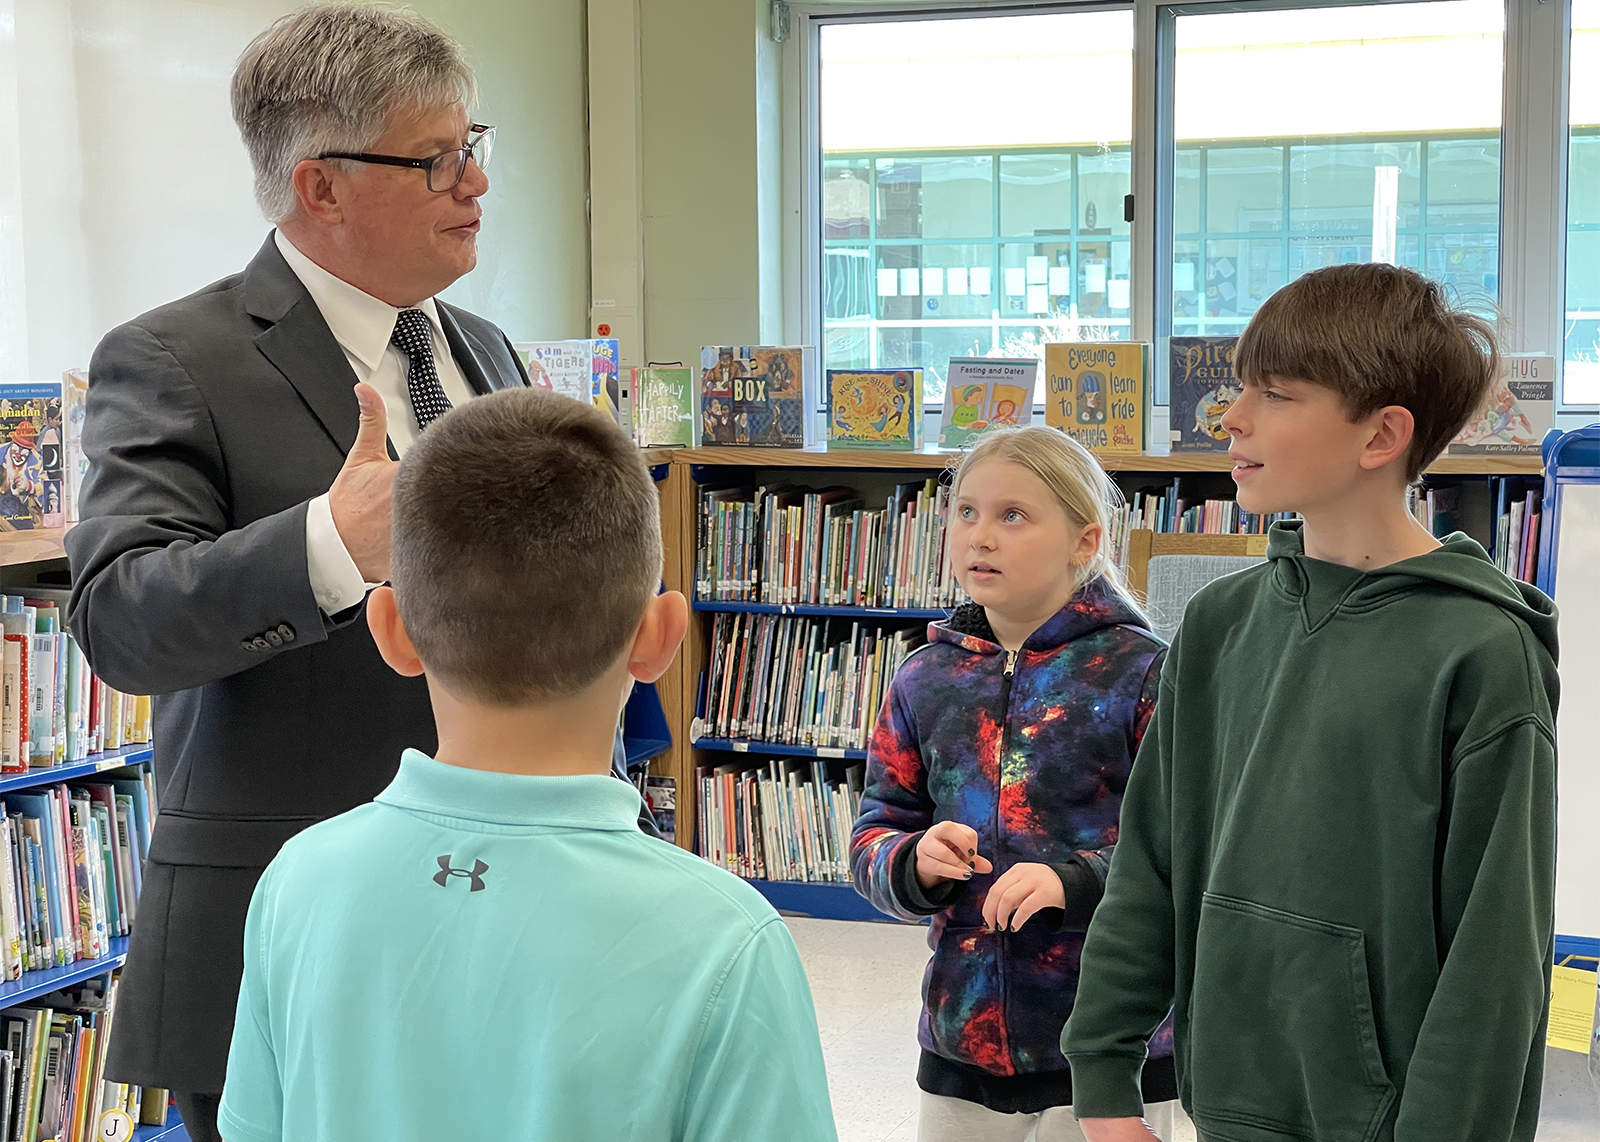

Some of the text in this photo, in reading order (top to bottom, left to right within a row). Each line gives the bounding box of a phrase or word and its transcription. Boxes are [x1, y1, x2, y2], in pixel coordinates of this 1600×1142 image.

[535, 347, 562, 360] Sam
[592, 344, 614, 359] UGE
[1068, 347, 1117, 371] Everyone
[544, 356, 585, 369] TIGERS
[960, 366, 1025, 375] Fasting and Dates
[1511, 359, 1538, 379] HUG
[1196, 367, 1234, 379] GUI
[645, 382, 684, 400] HAPPILY
[734, 379, 767, 402] BOX
[838, 378, 855, 396] RISE
[870, 376, 892, 397] SHINE
[1109, 371, 1137, 396] learn
[1516, 382, 1548, 390] Laurence
[1521, 391, 1546, 400] Pringle
[648, 405, 680, 423] AFTER
[1058, 397, 1135, 420] to ride
[105, 1118, 120, 1137] J
